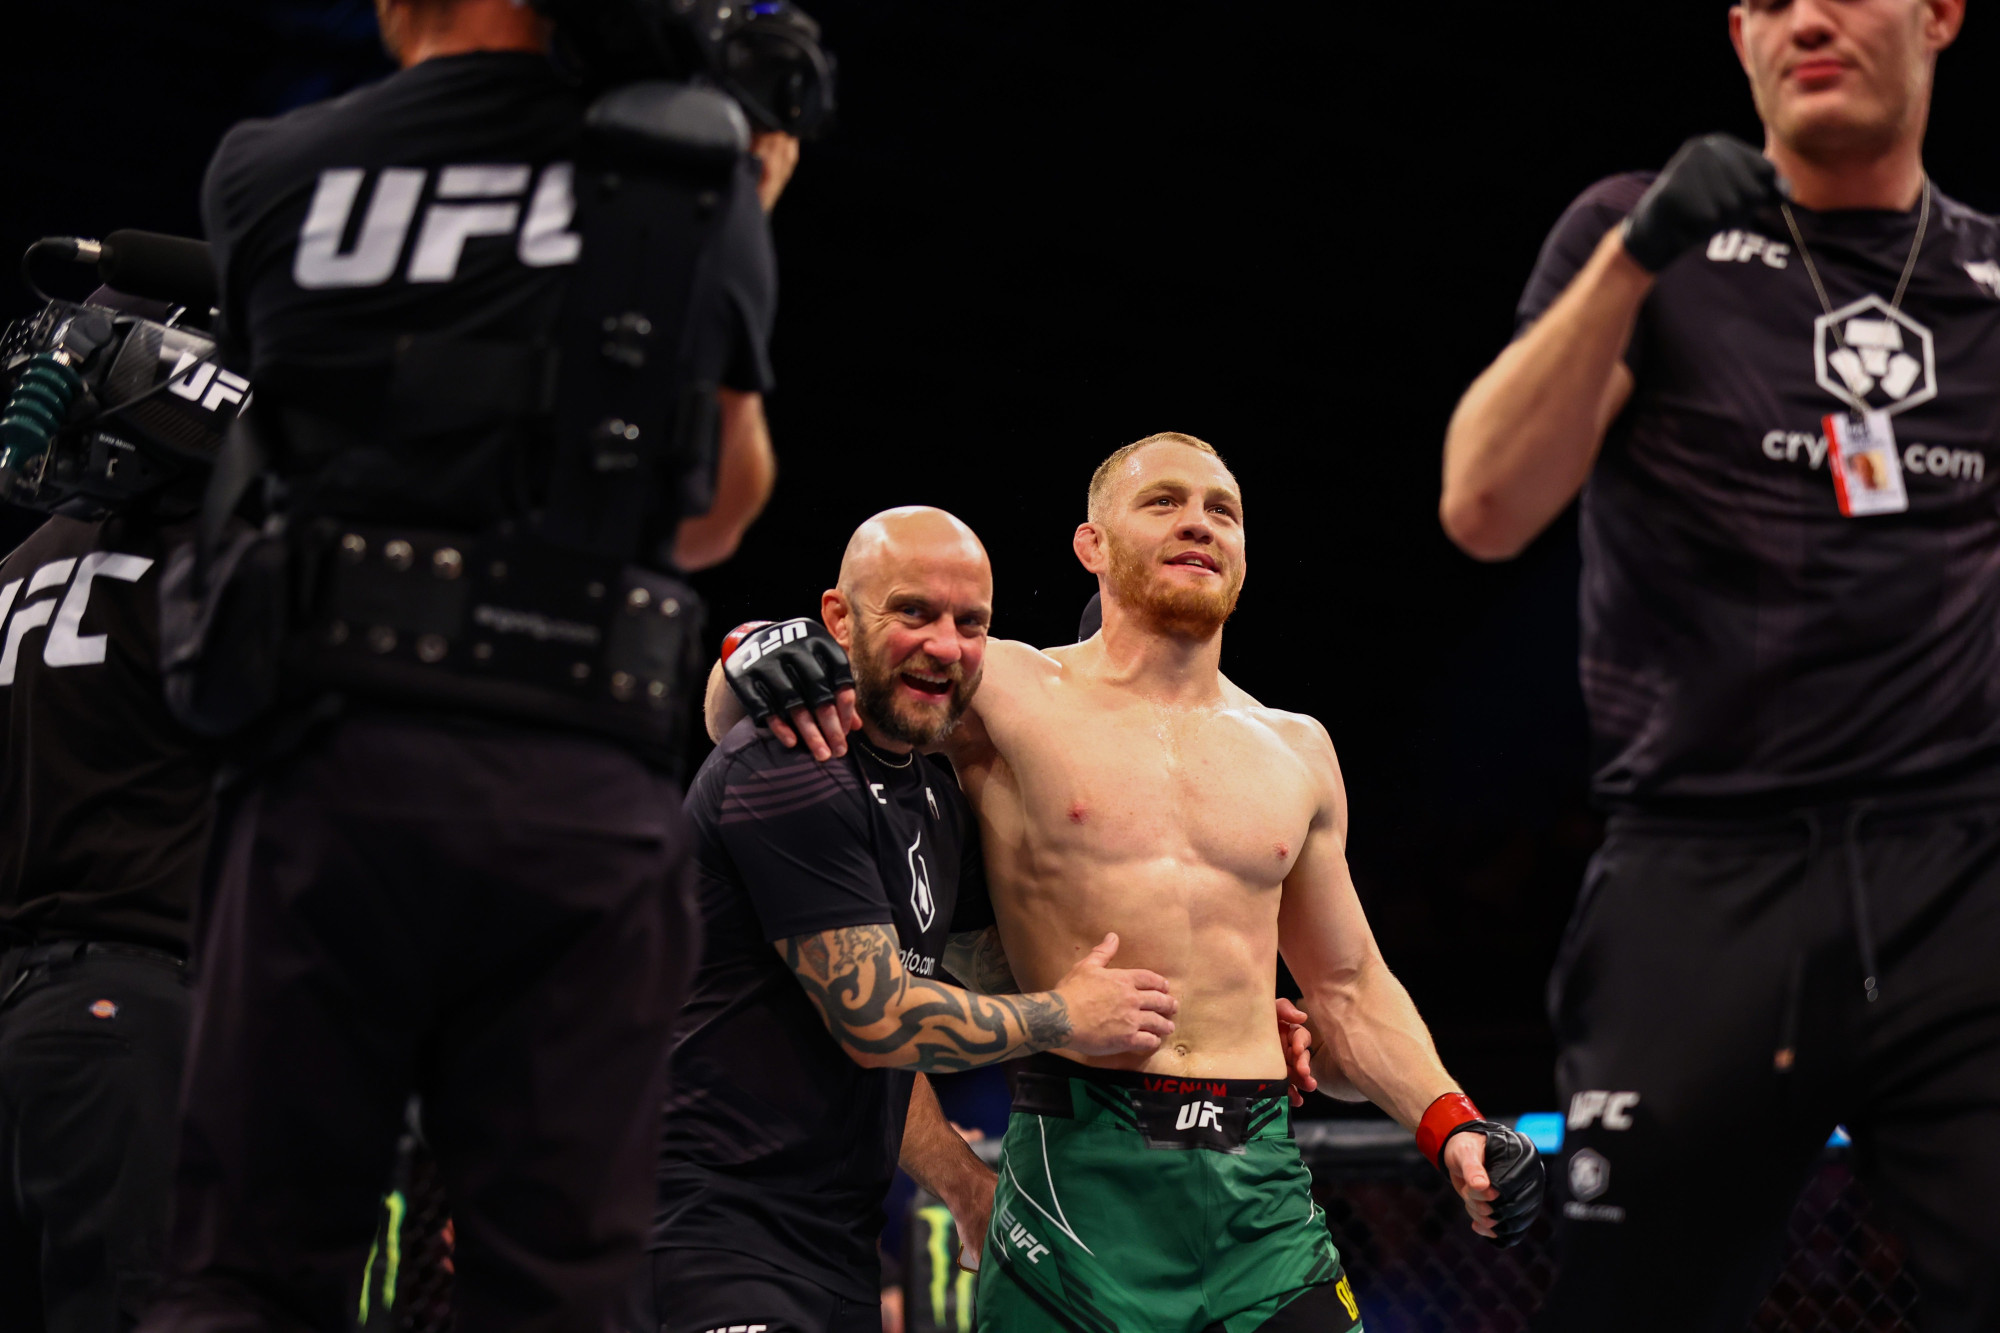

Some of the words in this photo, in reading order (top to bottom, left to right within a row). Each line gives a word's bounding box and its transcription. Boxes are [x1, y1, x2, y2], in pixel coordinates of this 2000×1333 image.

[1706, 227, 1791, 270] UFC
[167, 351, 254, 419] UF
[742, 621, 809, 671] UFC
[1175, 1100, 1225, 1133] UFC
[1009, 1222, 1051, 1265] UFC
